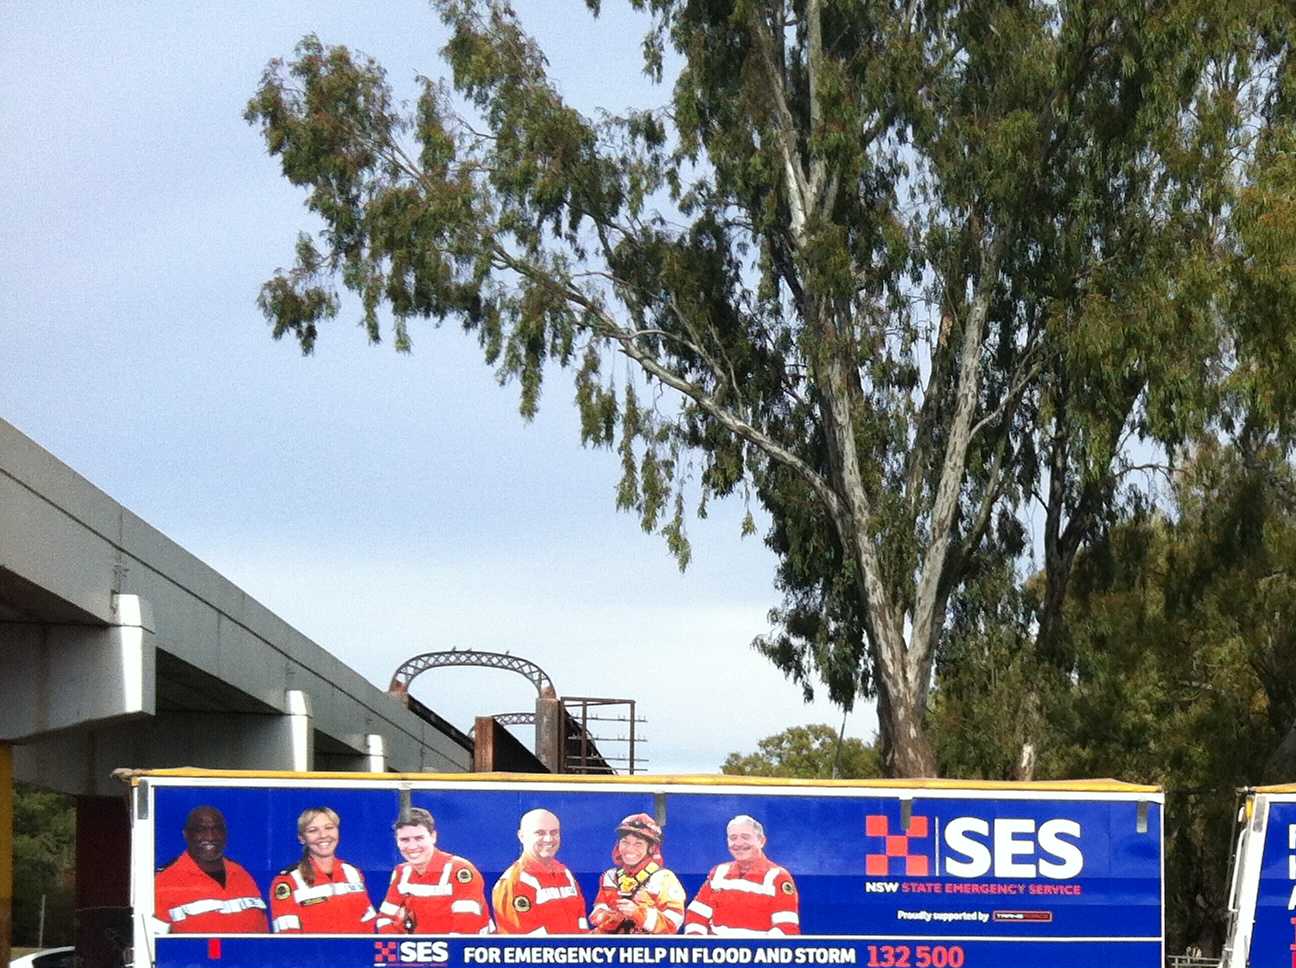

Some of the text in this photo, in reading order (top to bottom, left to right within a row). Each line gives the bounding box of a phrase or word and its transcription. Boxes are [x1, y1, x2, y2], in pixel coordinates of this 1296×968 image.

[945, 817, 1083, 879] SES
[865, 882, 1081, 895] NSW STATE EMERGENCY SERVICE
[898, 910, 931, 922] Proudly
[932, 911, 974, 922] supported
[975, 911, 989, 922] by
[400, 942, 448, 963] SES
[464, 947, 855, 963] FOR EMERGENCY HELP IN FLOOD AND STORM
[866, 946, 964, 968] 132 500
